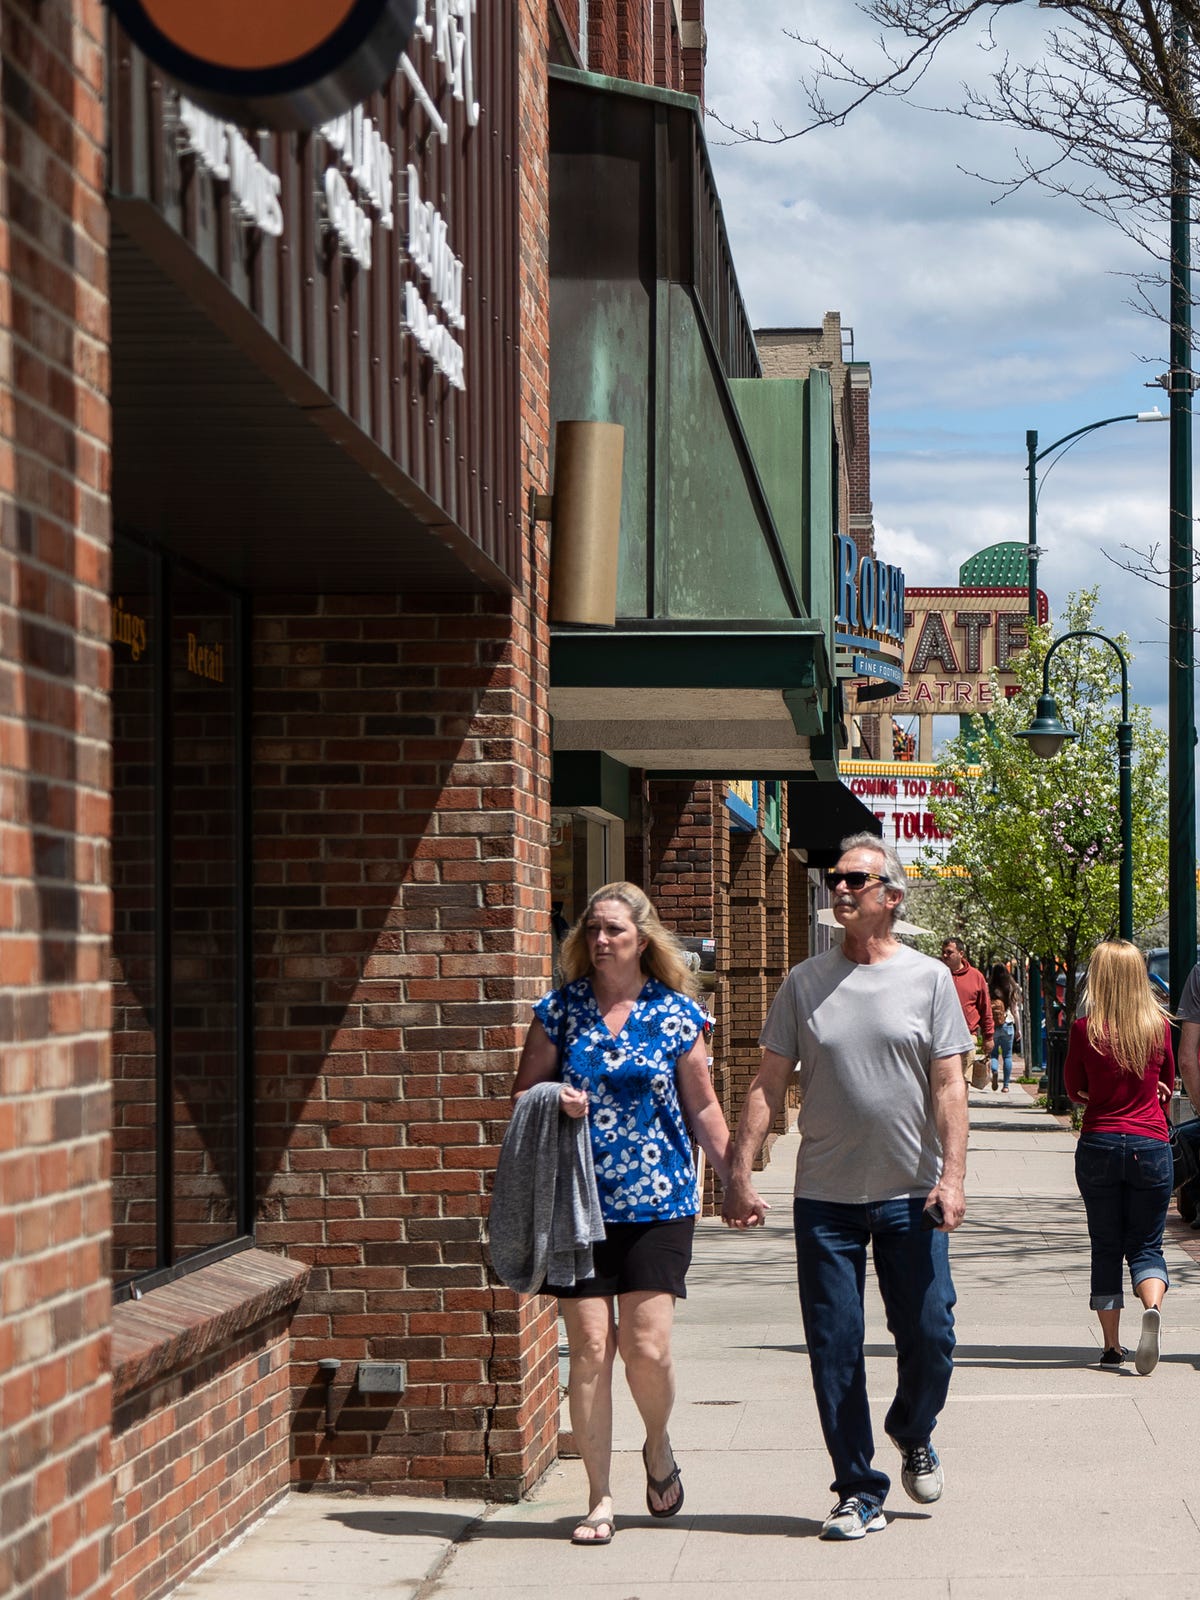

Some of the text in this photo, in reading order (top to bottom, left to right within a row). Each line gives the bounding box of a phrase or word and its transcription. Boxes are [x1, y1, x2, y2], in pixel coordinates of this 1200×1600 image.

[187, 632, 224, 682] Retail
[860, 660, 877, 673] FINE
[850, 779, 898, 797] COMING
[902, 780, 927, 797] TOO
